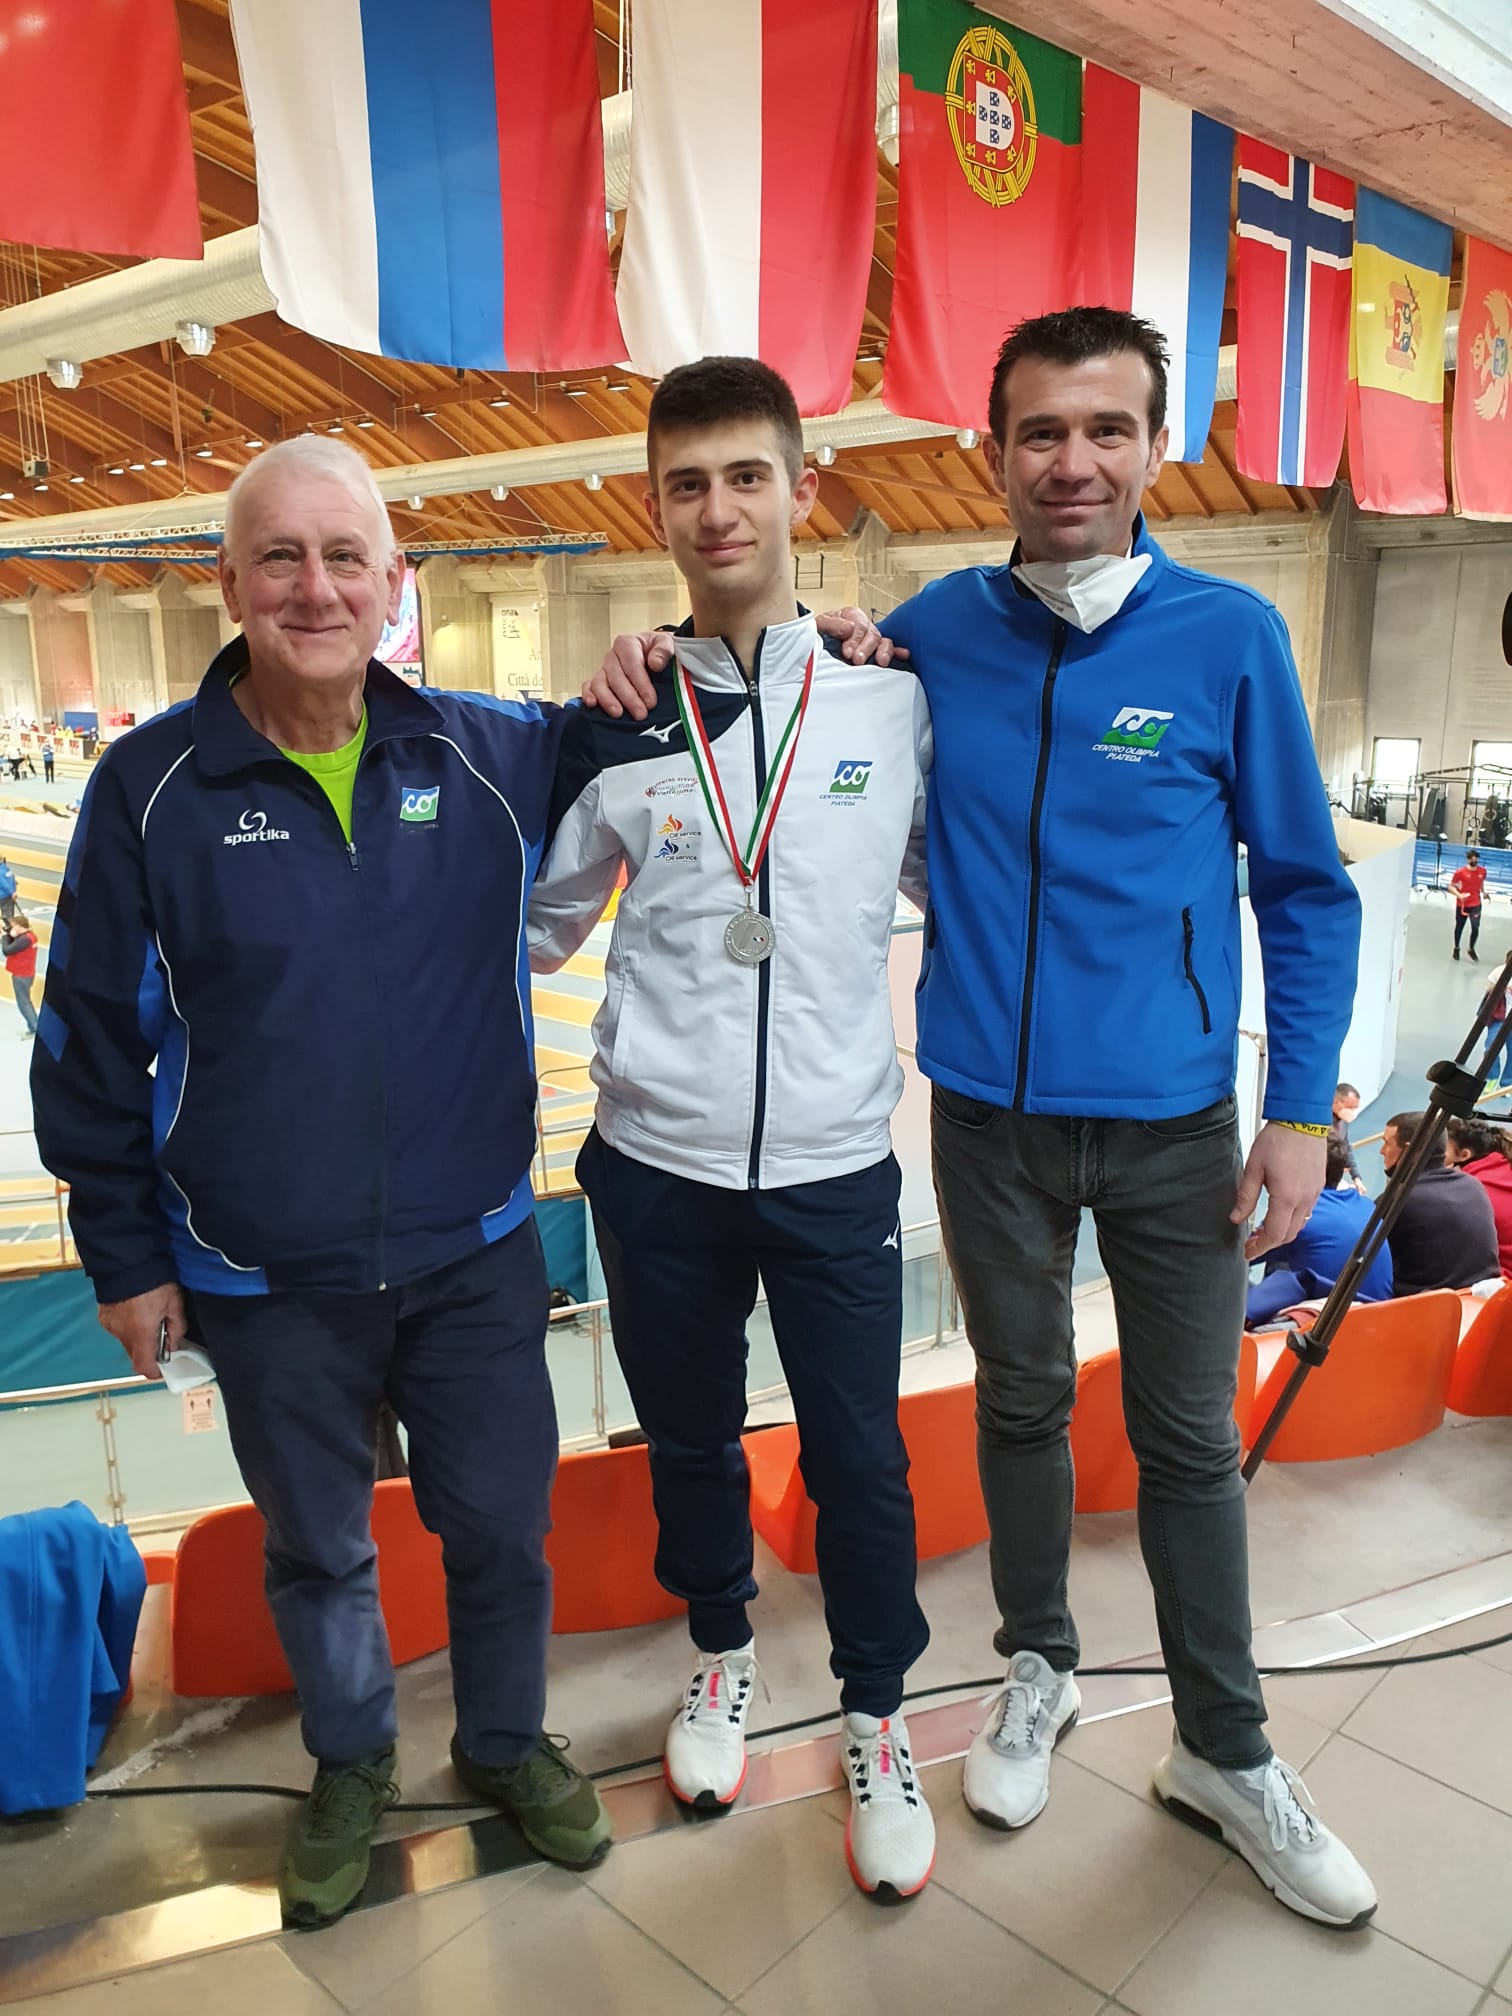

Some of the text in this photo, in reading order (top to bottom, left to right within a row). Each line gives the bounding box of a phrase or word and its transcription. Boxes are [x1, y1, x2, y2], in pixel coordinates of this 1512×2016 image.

[1092, 744, 1160, 758] CENTRO OLIMPIA
[1105, 752, 1142, 762] PIATEDA
[223, 828, 290, 847] sportika
